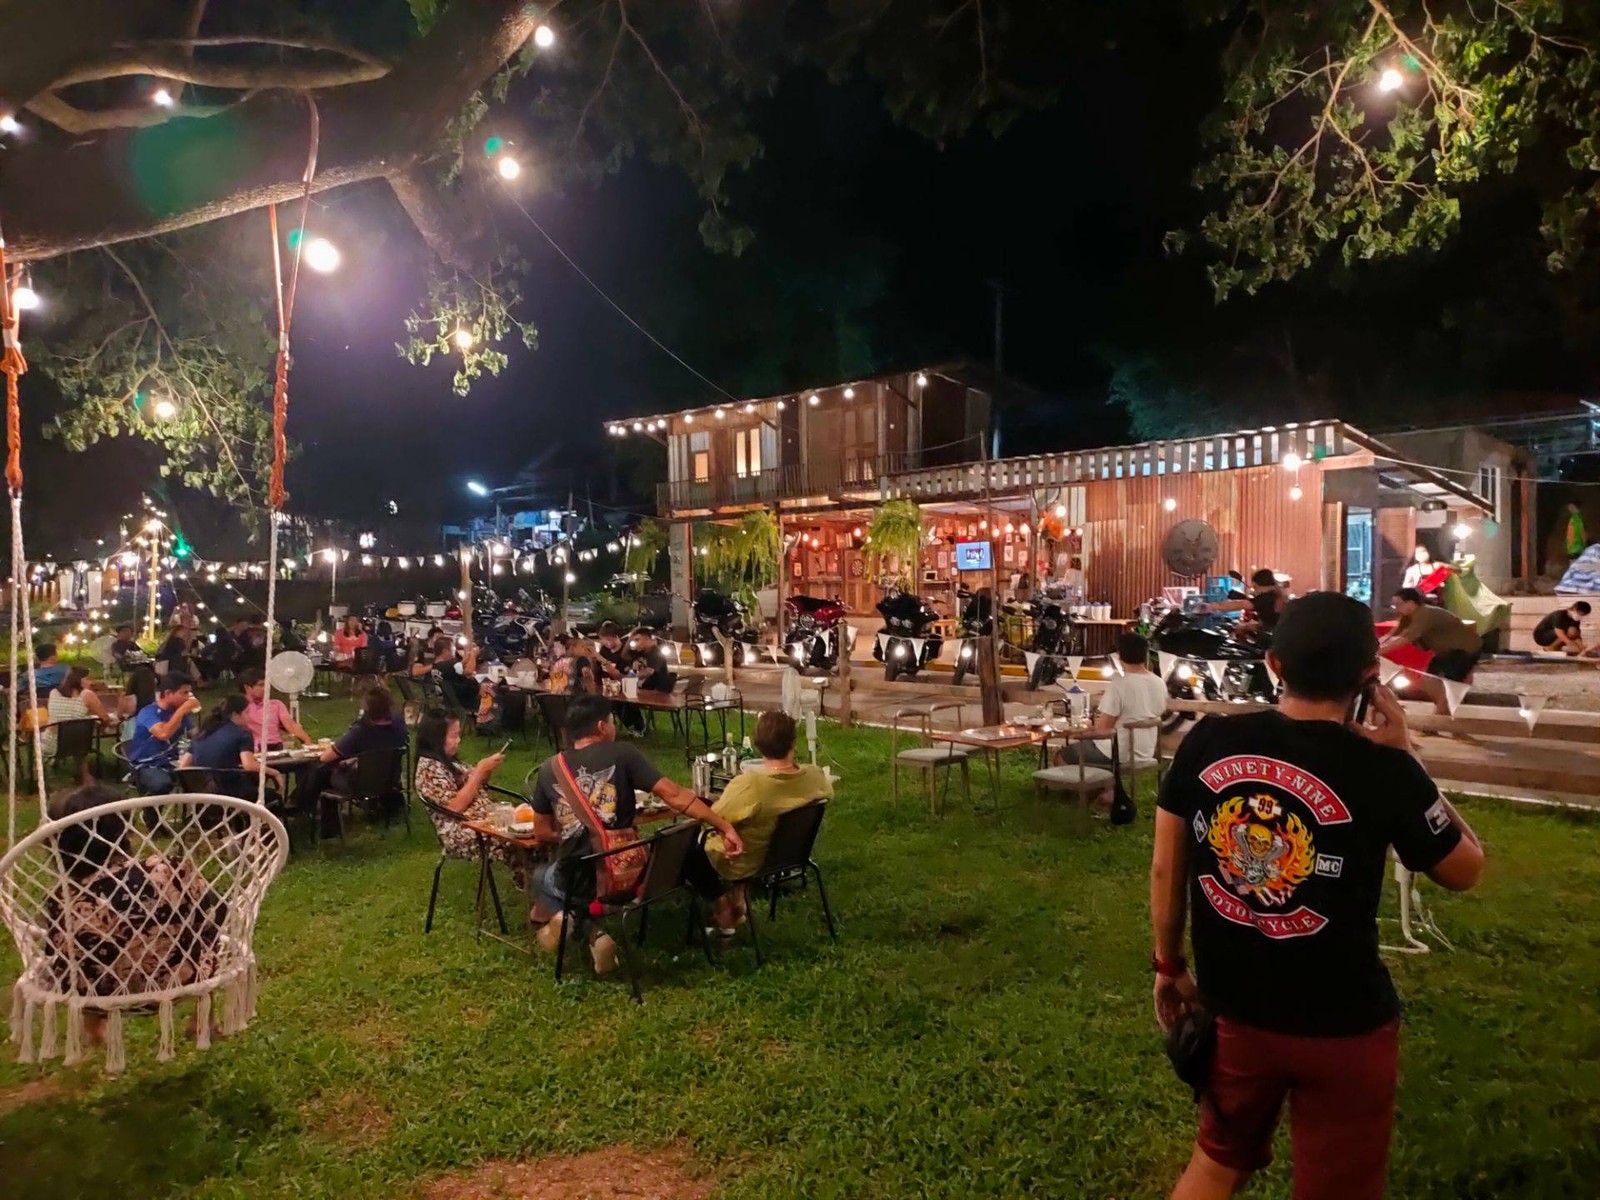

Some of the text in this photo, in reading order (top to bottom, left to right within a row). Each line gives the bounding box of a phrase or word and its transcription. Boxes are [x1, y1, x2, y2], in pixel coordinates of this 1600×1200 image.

[1210, 761, 1337, 818] NINETY-NINE
[1258, 797, 1273, 815] 99
[1318, 859, 1340, 873] MC
